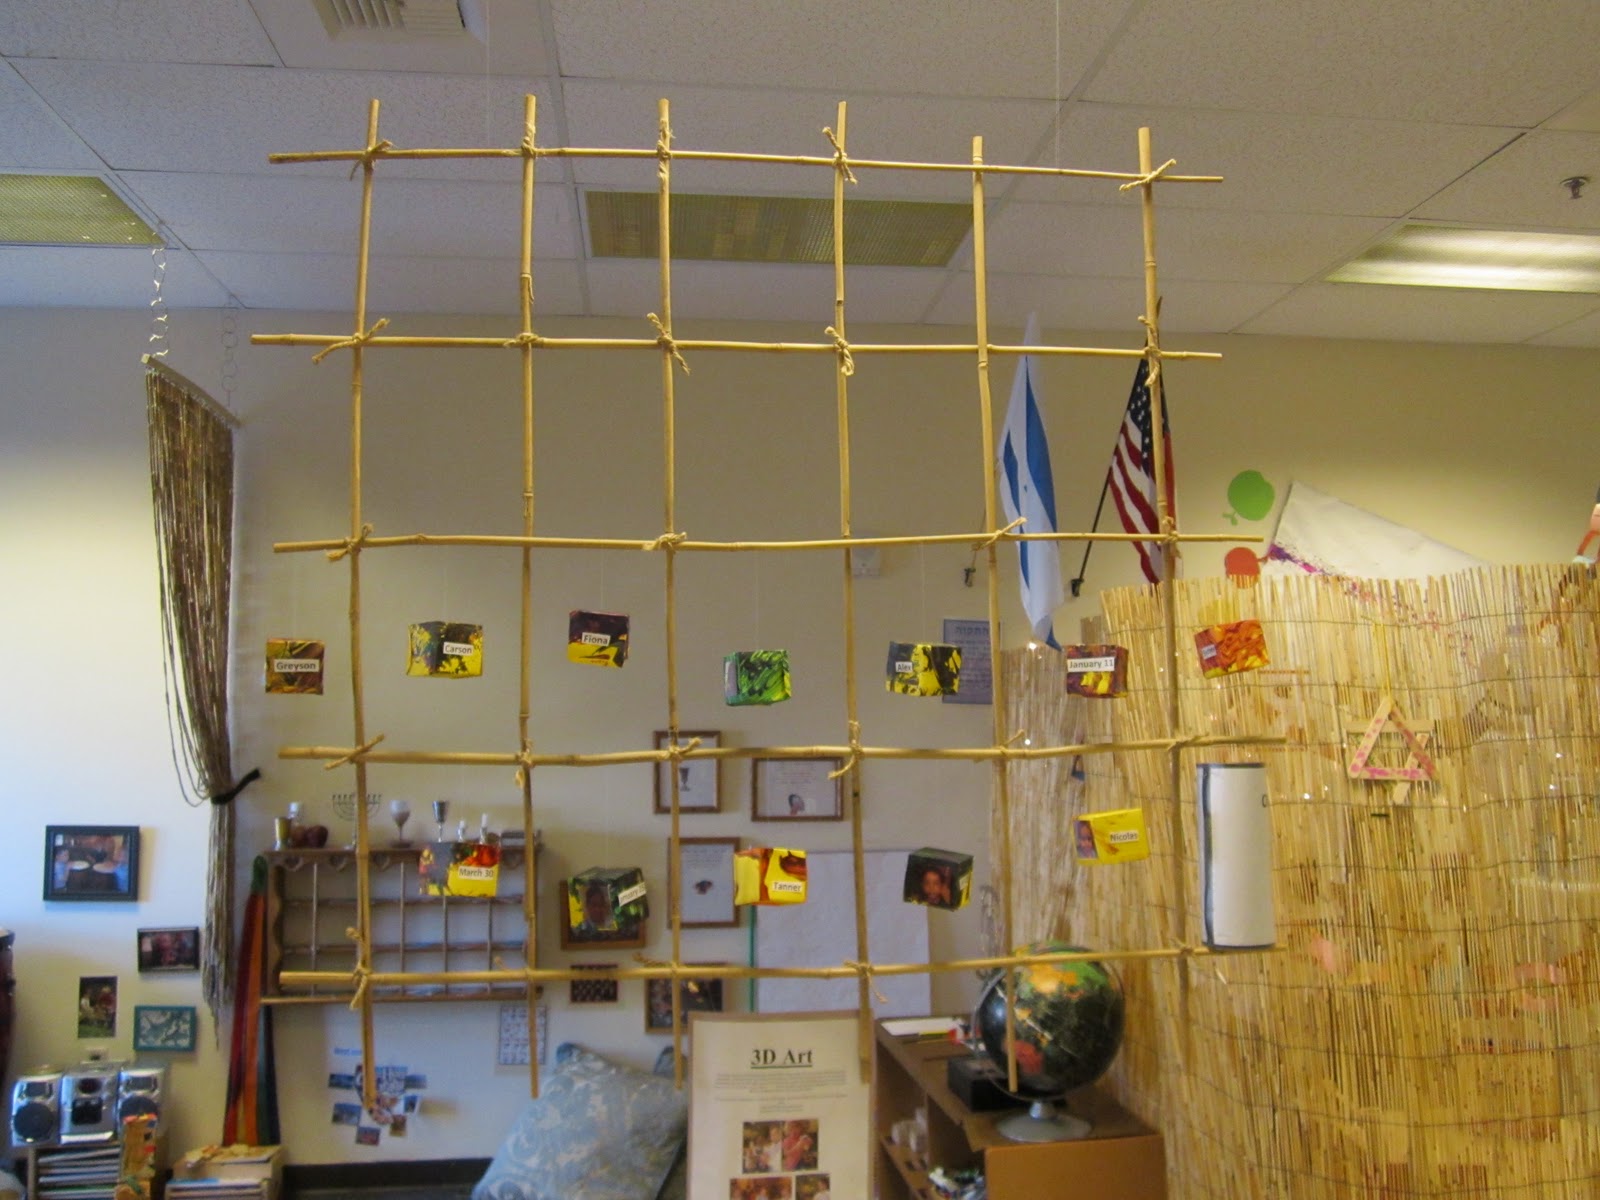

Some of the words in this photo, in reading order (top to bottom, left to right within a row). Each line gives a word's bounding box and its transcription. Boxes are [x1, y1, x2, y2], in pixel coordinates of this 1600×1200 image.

[583, 634, 608, 645] Fiona
[445, 644, 472, 654] Carson
[276, 661, 316, 671] Greyson
[1069, 660, 1102, 669] January
[1109, 831, 1138, 842] Nicolas
[459, 868, 482, 877] March
[773, 881, 801, 892] Tanner
[751, 1048, 776, 1065] 3D
[783, 1048, 812, 1065] Art
